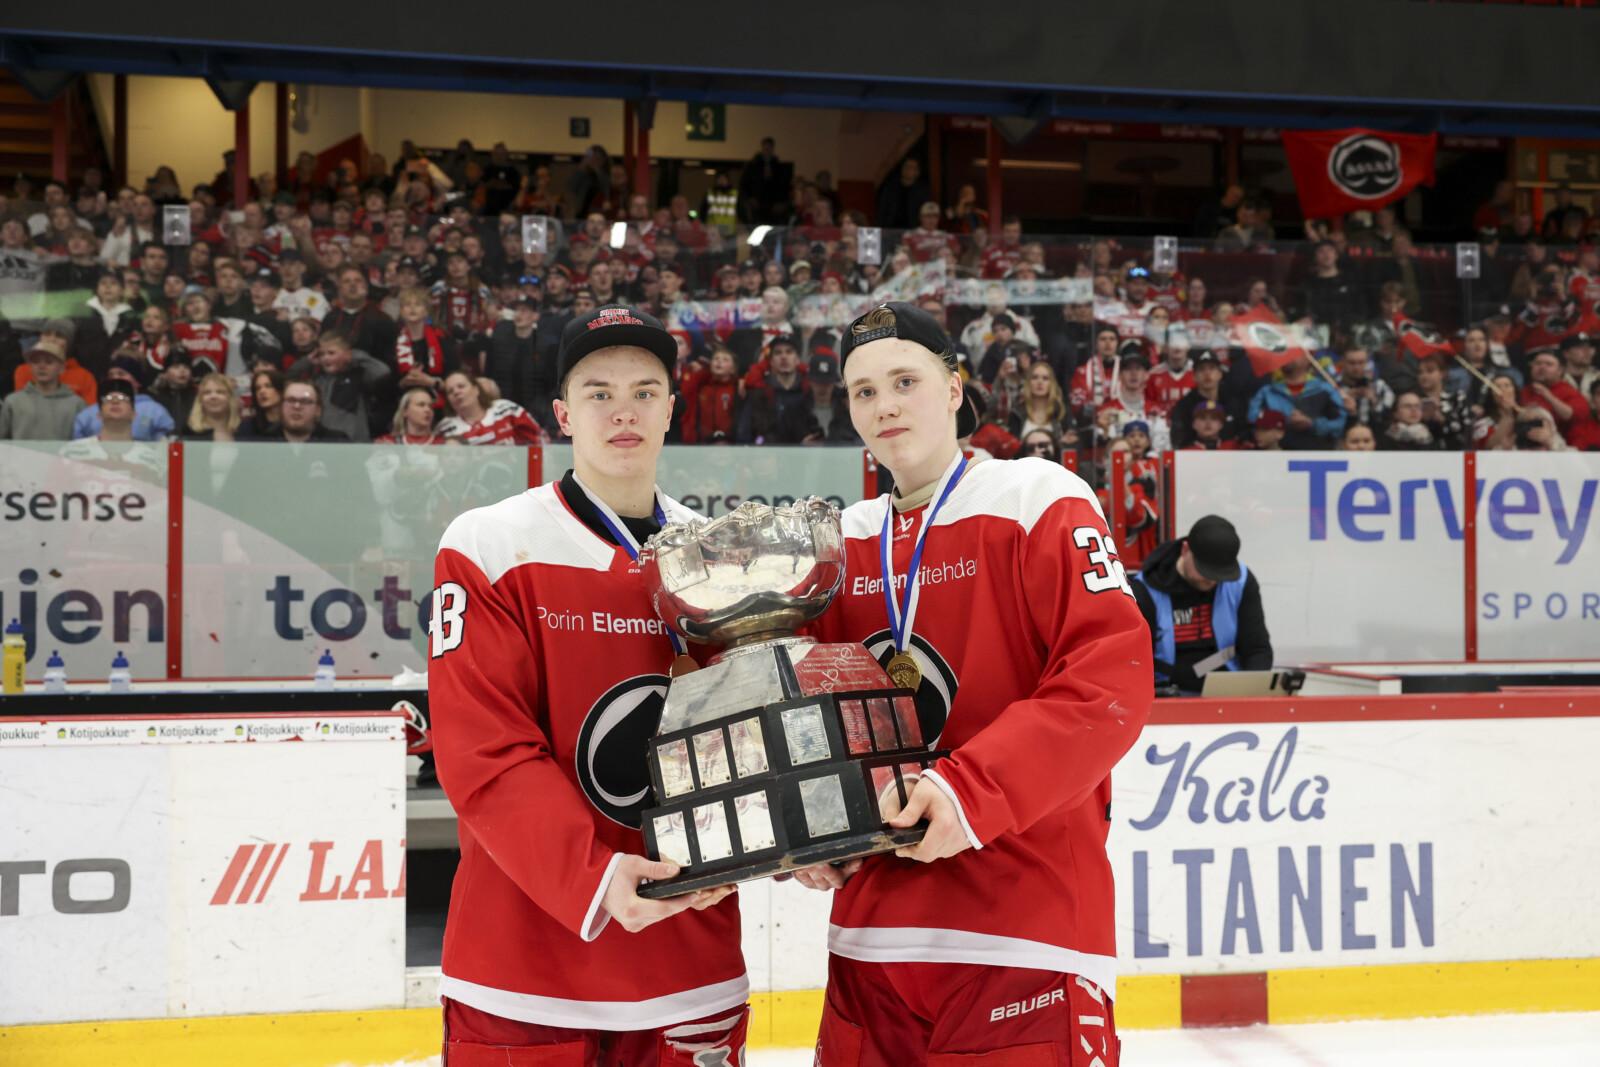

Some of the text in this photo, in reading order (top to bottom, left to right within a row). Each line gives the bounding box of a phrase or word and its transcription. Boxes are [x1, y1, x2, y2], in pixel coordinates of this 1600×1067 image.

[700, 107, 714, 136] 3
[0, 491, 147, 521] sense
[1288, 460, 1600, 565] Tervey
[0, 568, 165, 664] jen
[265, 575, 433, 642] tot
[536, 606, 584, 632] Porin
[1482, 592, 1600, 620] SPOR
[1128, 726, 1330, 831] Kala
[1132, 842, 1435, 959] LTANEN
[989, 988, 1066, 1022] BAUER
